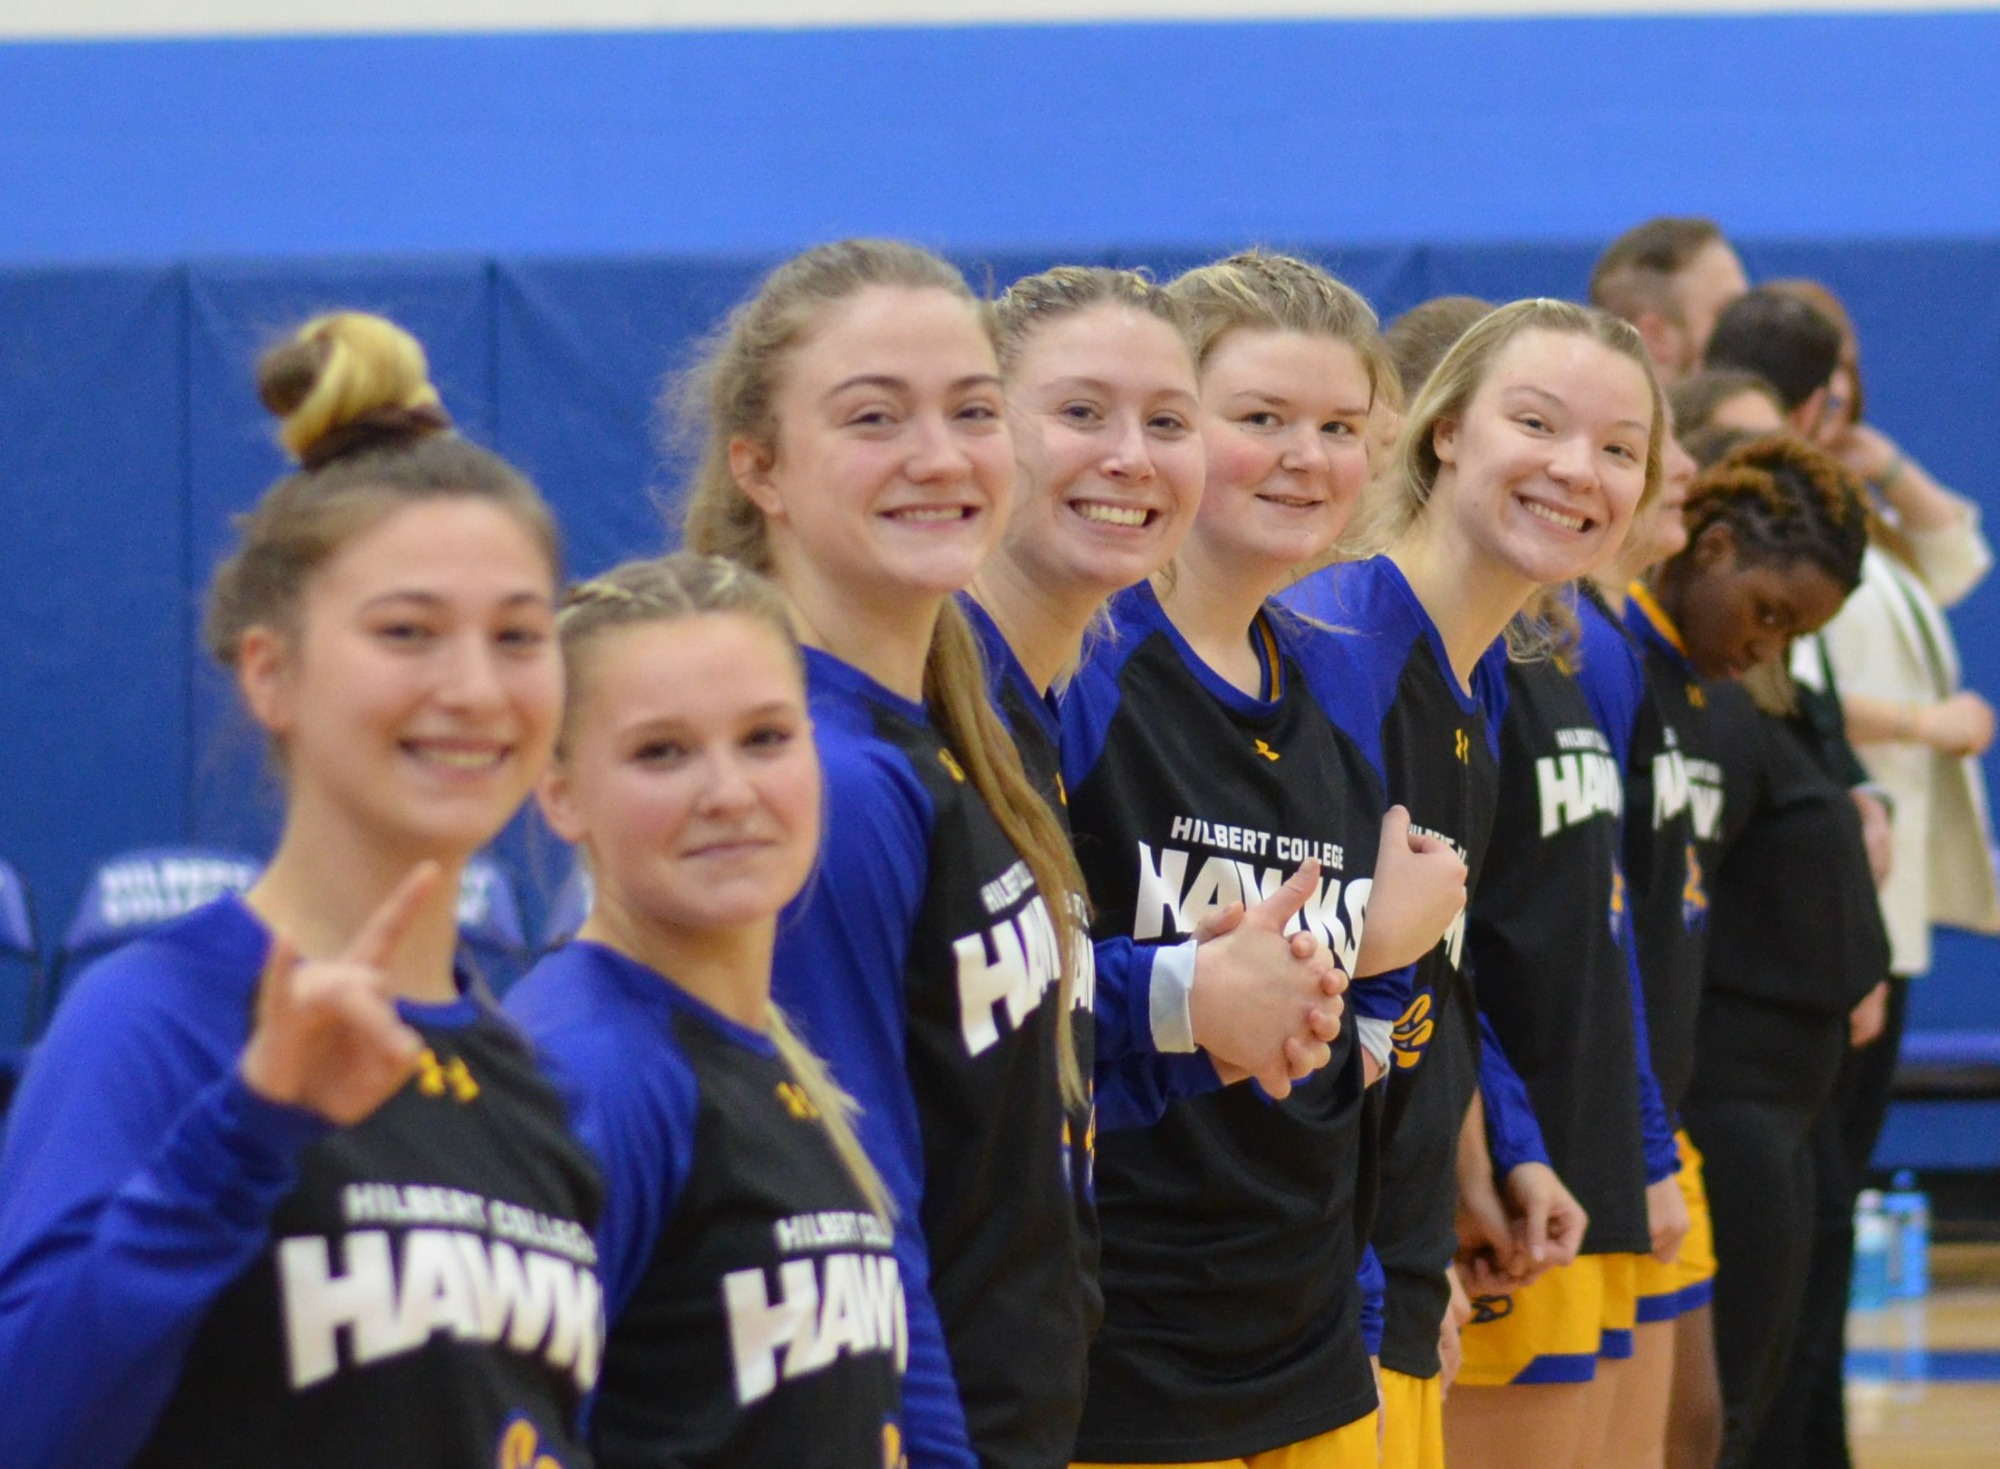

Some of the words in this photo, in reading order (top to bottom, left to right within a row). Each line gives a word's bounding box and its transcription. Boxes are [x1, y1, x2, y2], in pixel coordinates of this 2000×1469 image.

[1171, 816, 1271, 857] HILBERT
[1276, 836, 1344, 871] COLLEGE
[343, 1182, 486, 1230] HILBERT
[277, 1227, 606, 1392] HAWK
